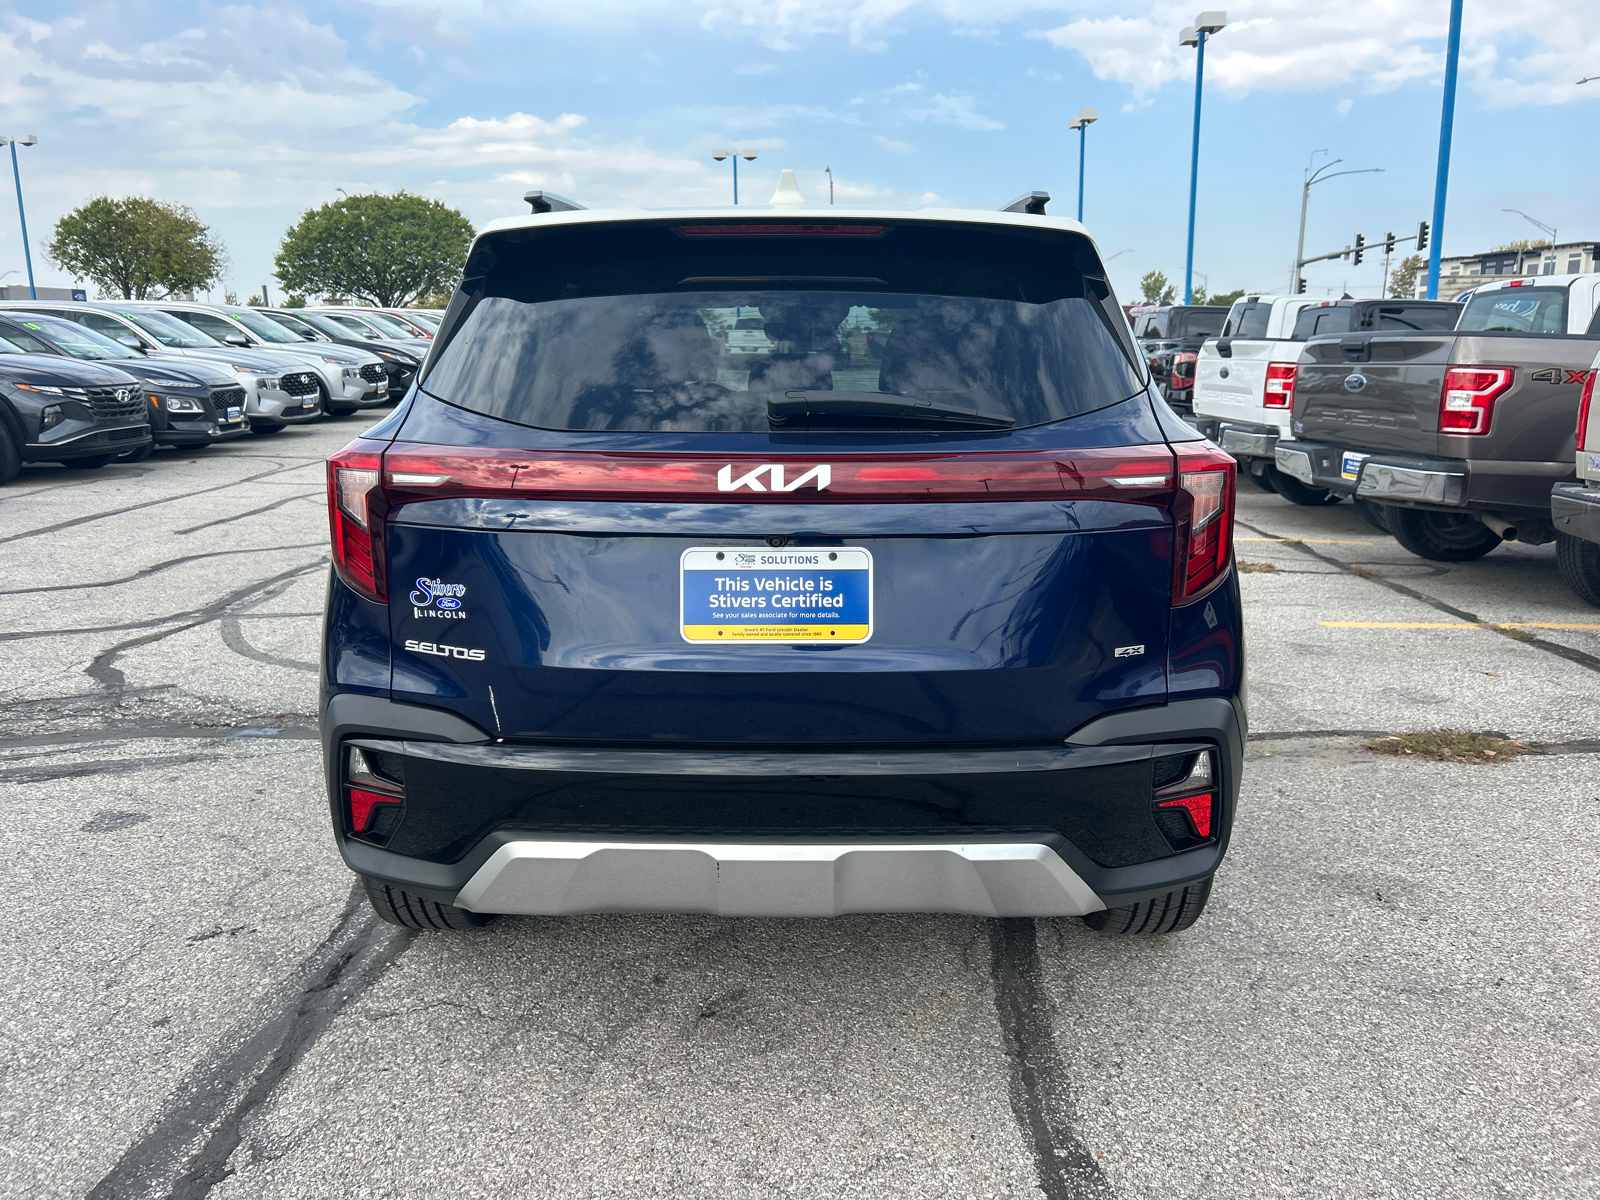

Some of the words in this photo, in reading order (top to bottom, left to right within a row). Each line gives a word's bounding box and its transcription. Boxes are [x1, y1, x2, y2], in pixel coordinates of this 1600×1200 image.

[717, 463, 831, 492] KIA
[760, 555, 819, 565] SOLUTIONS
[714, 576, 750, 591] This
[754, 576, 815, 591] Vehicle
[819, 576, 833, 591] is
[409, 577, 466, 607] Stivers
[709, 593, 767, 608] Stivers
[771, 593, 843, 608] Certified
[418, 609, 466, 619] LINCOLN
[404, 639, 486, 661] SELTOS
